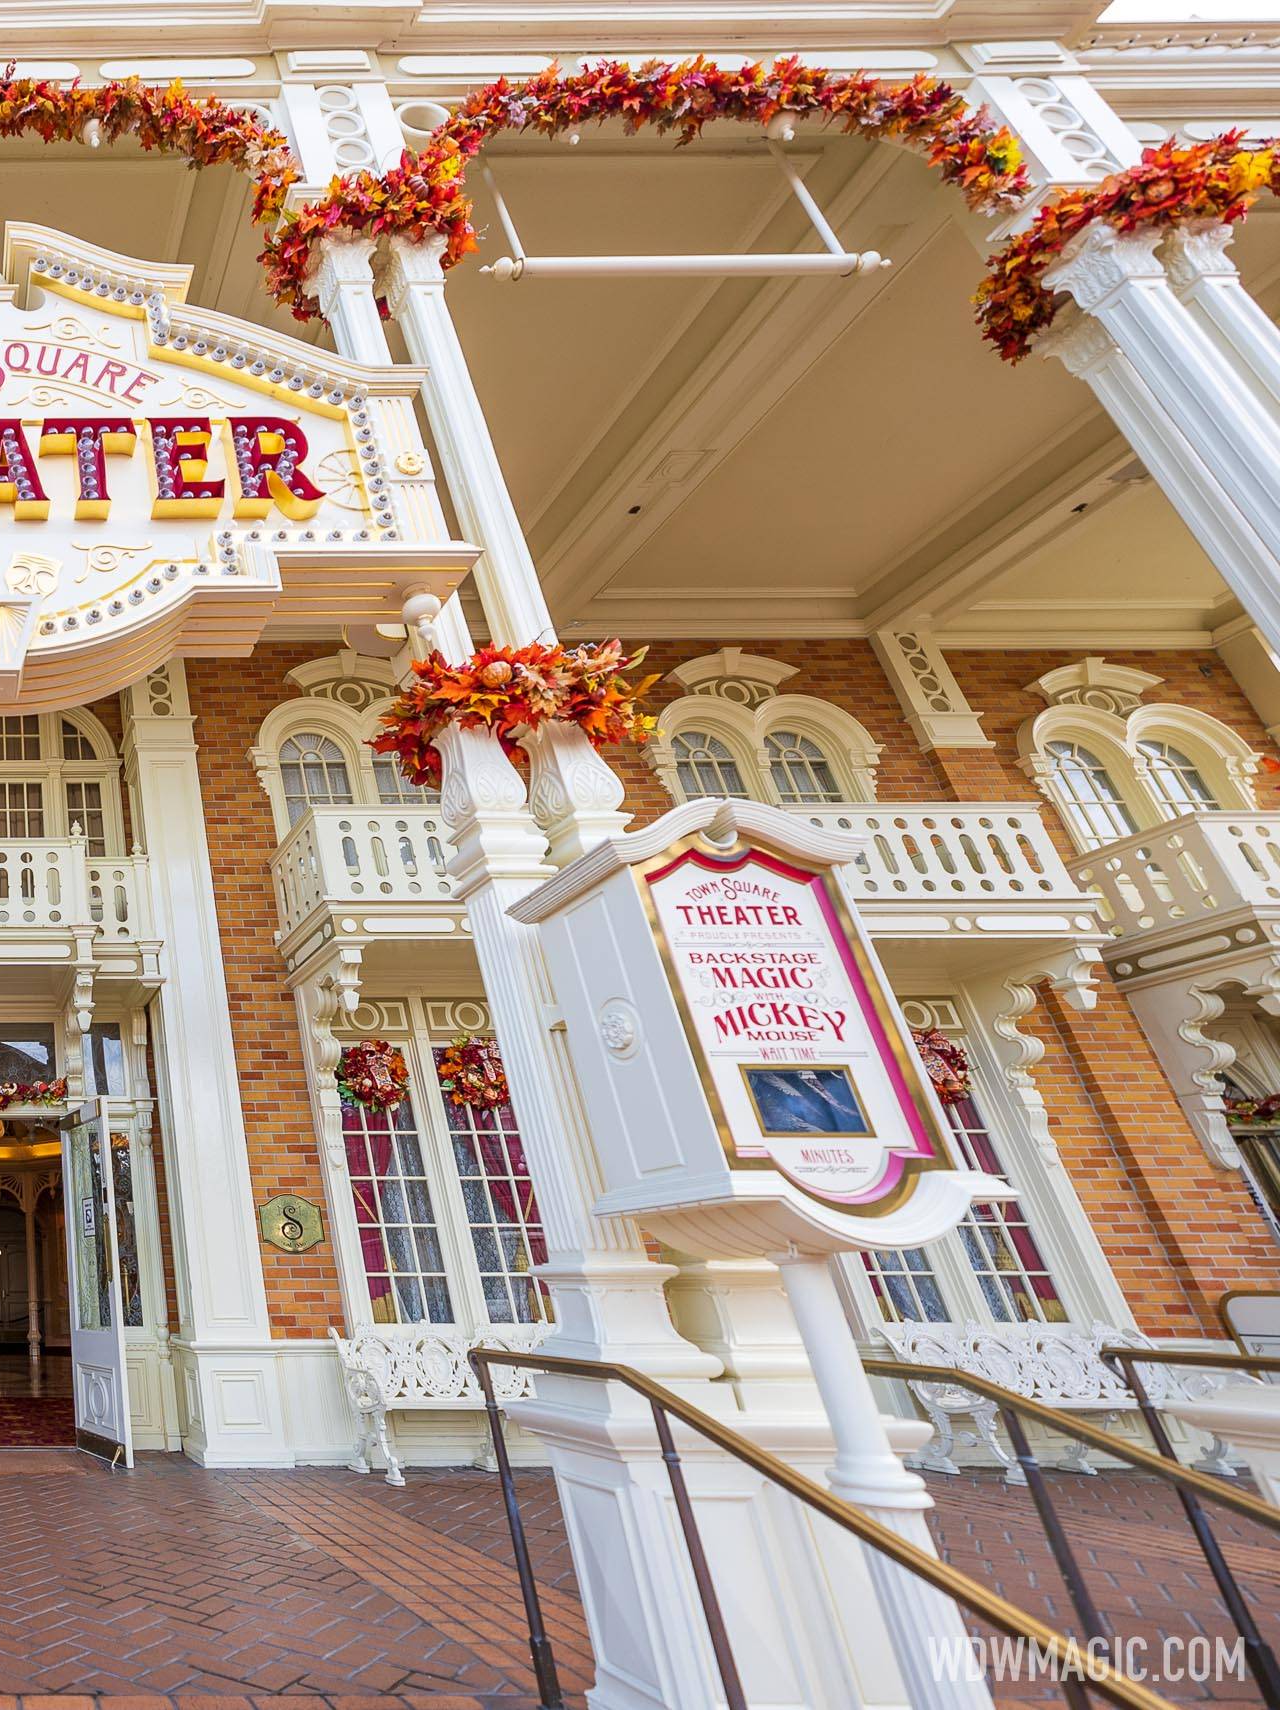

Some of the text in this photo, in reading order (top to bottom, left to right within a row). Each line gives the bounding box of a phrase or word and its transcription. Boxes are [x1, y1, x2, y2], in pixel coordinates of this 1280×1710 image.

[685, 877, 782, 903] TOWN SQUARE
[676, 905, 803, 926] THEATER
[689, 931, 802, 940] PROUDLY PRESENTS
[688, 952, 823, 965] BACKSTAGE
[711, 967, 813, 989] MAGIC
[754, 992, 786, 1001] WITH
[713, 1002, 847, 1044] MICKEY
[747, 1030, 821, 1042] MOUSE
[758, 1047, 817, 1061] WAIT TIME
[800, 1149, 855, 1164] MINUTES
